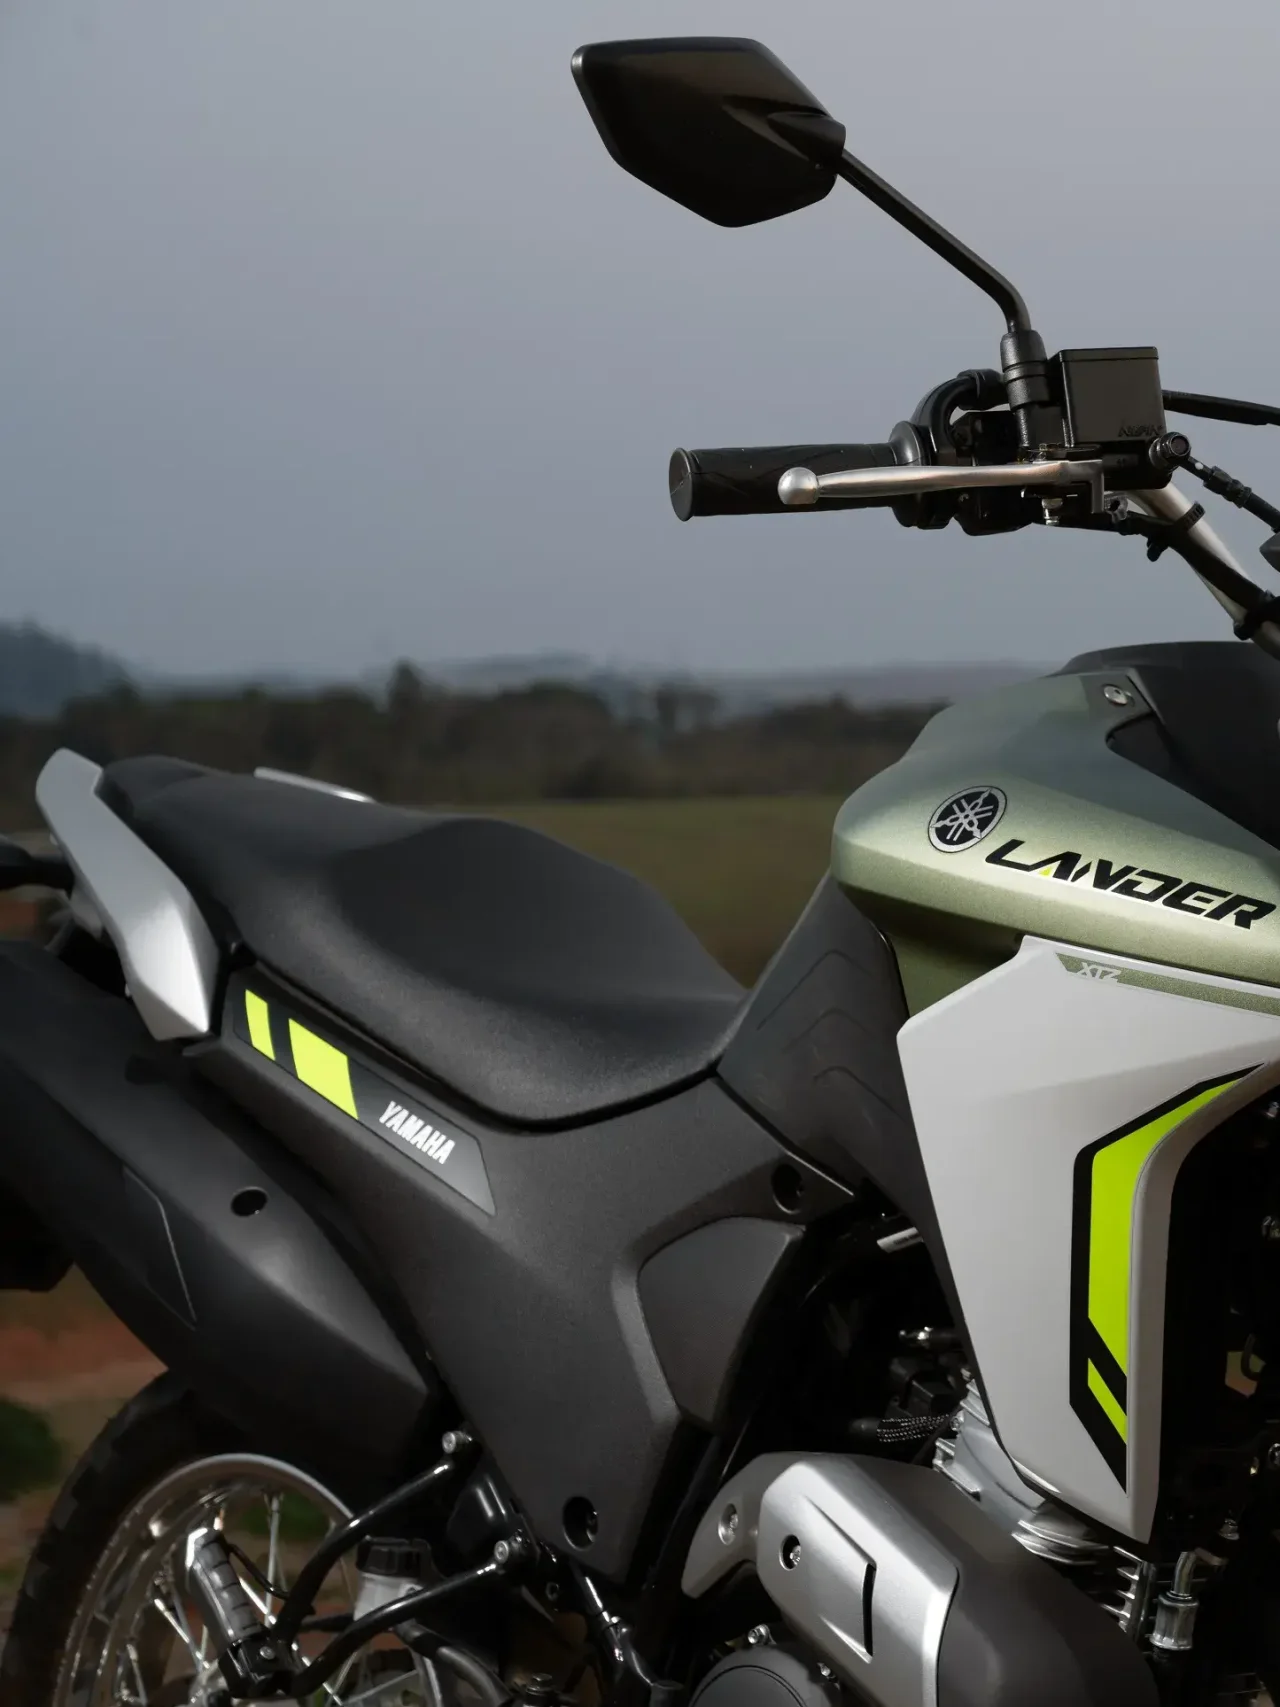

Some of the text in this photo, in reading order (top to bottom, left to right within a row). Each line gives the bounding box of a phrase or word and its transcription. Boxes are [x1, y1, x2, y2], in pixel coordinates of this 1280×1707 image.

[985, 839, 1277, 929] LANDER
[1077, 961, 1121, 983] XTZ
[379, 1101, 455, 1164] YAMAHA
